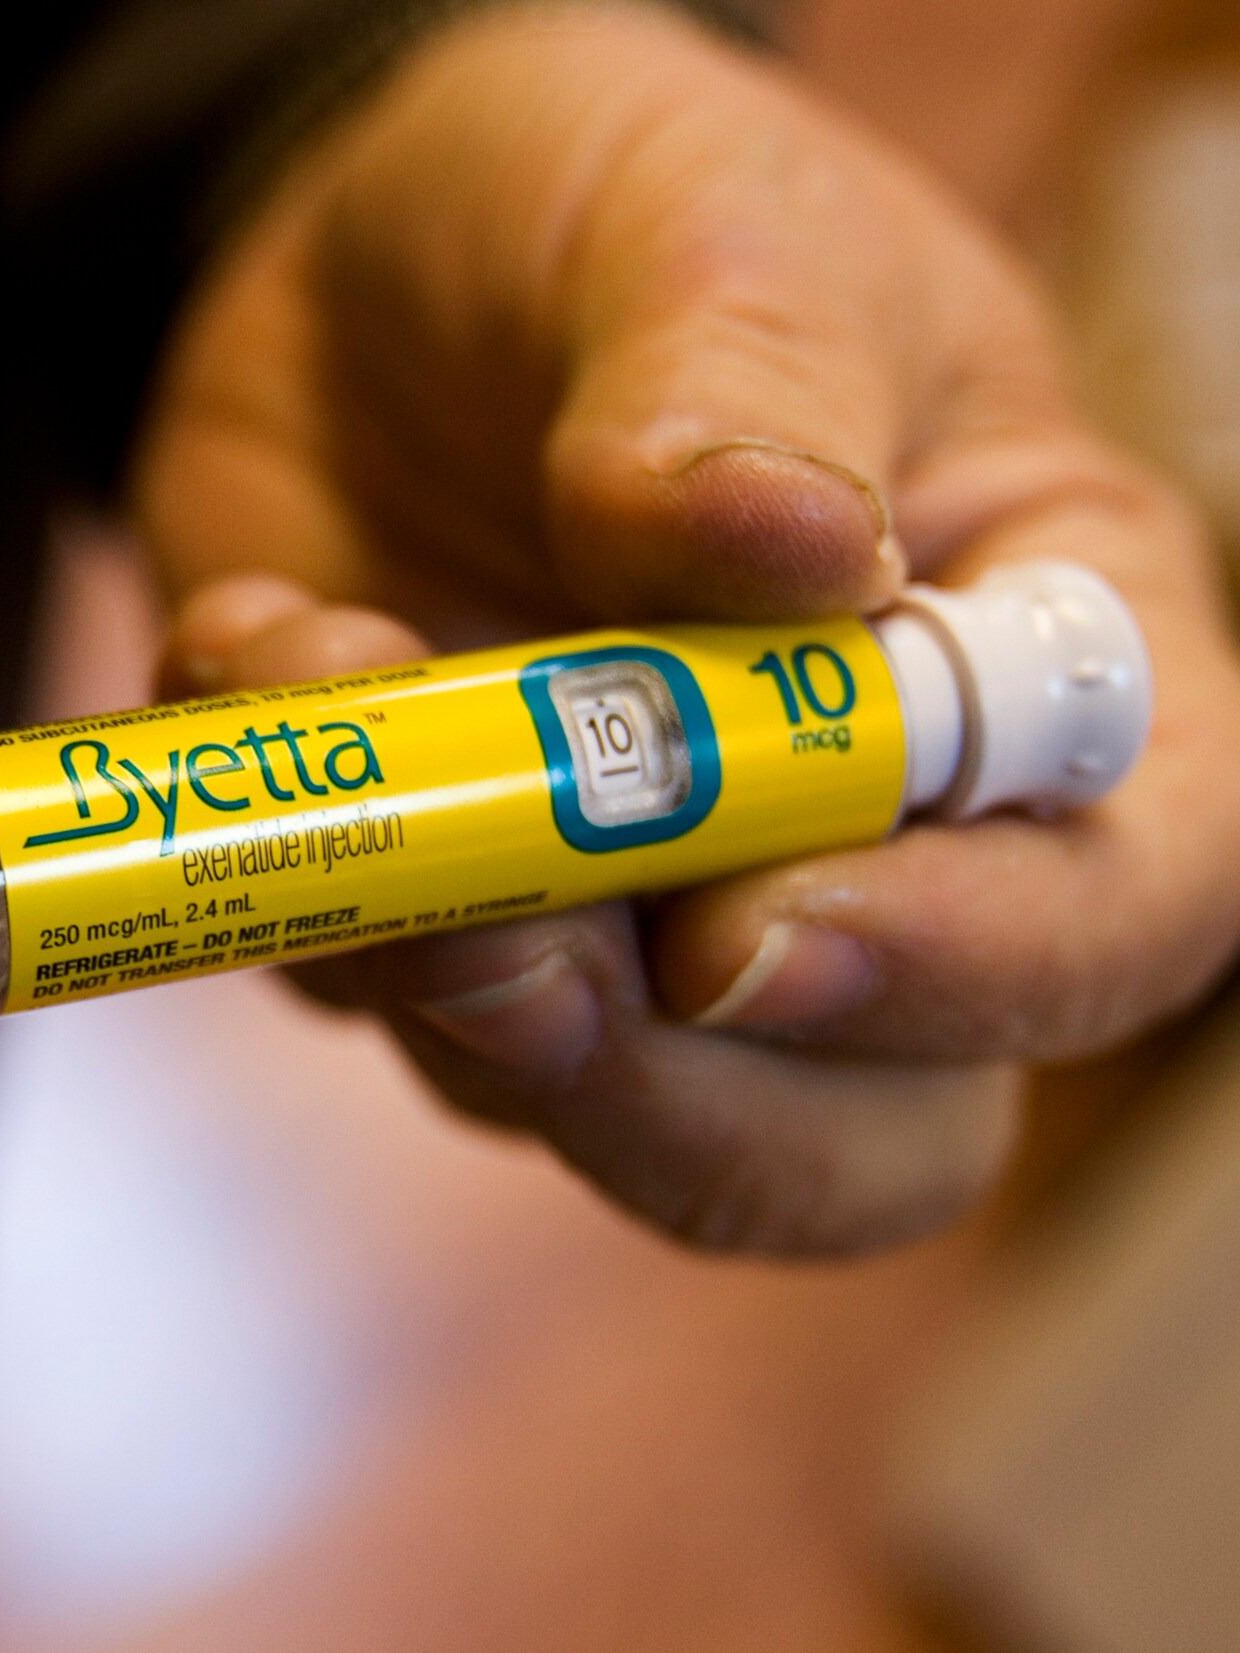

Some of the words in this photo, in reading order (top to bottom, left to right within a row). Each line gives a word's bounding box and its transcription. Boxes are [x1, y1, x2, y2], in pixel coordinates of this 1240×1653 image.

[18, 709, 181, 744] SUBCUTANEOUS
[183, 696, 259, 716] DOSES,
[261, 691, 286, 703] 10
[288, 685, 334, 699] mcg
[336, 677, 374, 691] PER
[377, 667, 431, 683] DOSE
[747, 642, 858, 726] 10
[585, 711, 634, 759] 10
[791, 723, 852, 754] mcg
[23, 720, 385, 858] Byetta
[182, 818, 302, 888] exenatide
[303, 803, 405, 874] injection
[32, 983, 64, 999] DO
[68, 972, 113, 993] NOT
[117, 951, 227, 984] TRANSFER
[231, 941, 278, 962] THIS
[281, 917, 408, 952] MEDICATION
[412, 911, 439, 926] TO
[442, 907, 457, 921] A
[462, 889, 551, 918] SYRINGE
[35, 939, 180, 982] REFRIGERATE
[202, 930, 233, 950] DO
[237, 920, 281, 944] NOT
[284, 905, 362, 935] FREEZE
[39, 924, 80, 951] 250
[86, 907, 180, 941] mcg/mL,
[185, 898, 219, 924] 2.4
[225, 892, 257, 916] mL
